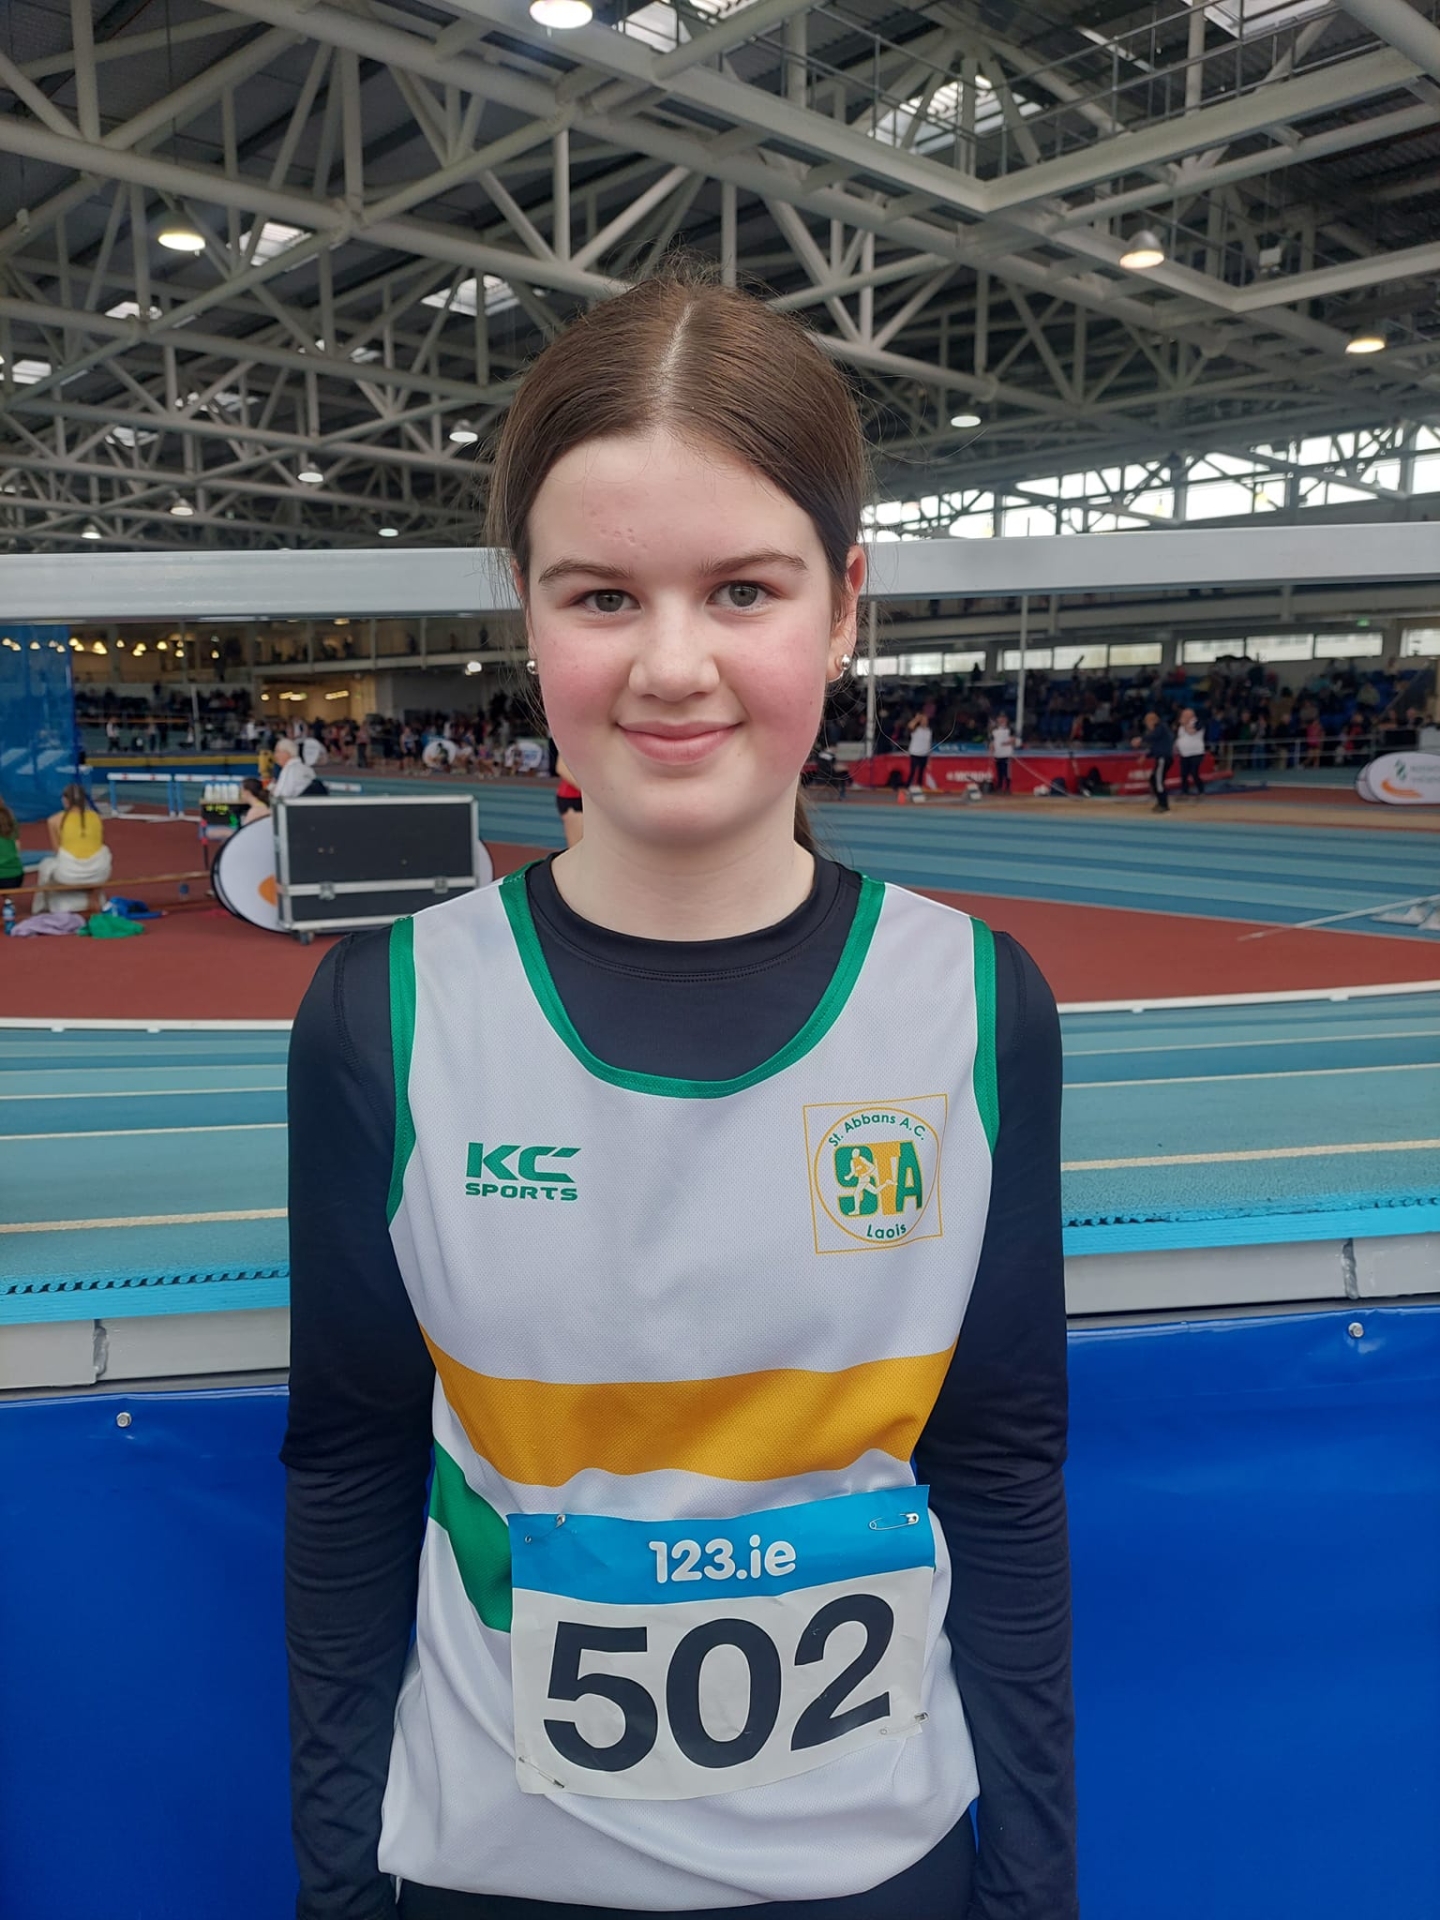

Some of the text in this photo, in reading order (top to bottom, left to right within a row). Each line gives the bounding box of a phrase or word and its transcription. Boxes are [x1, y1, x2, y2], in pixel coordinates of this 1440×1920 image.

[828, 1113, 926, 1148] St. Abbans A.C.
[466, 1141, 581, 1183] KC
[465, 1182, 578, 1201] SPORTS
[866, 1223, 907, 1239] Laois
[648, 1534, 797, 1584] 123.ie
[543, 1593, 894, 1772] 502
